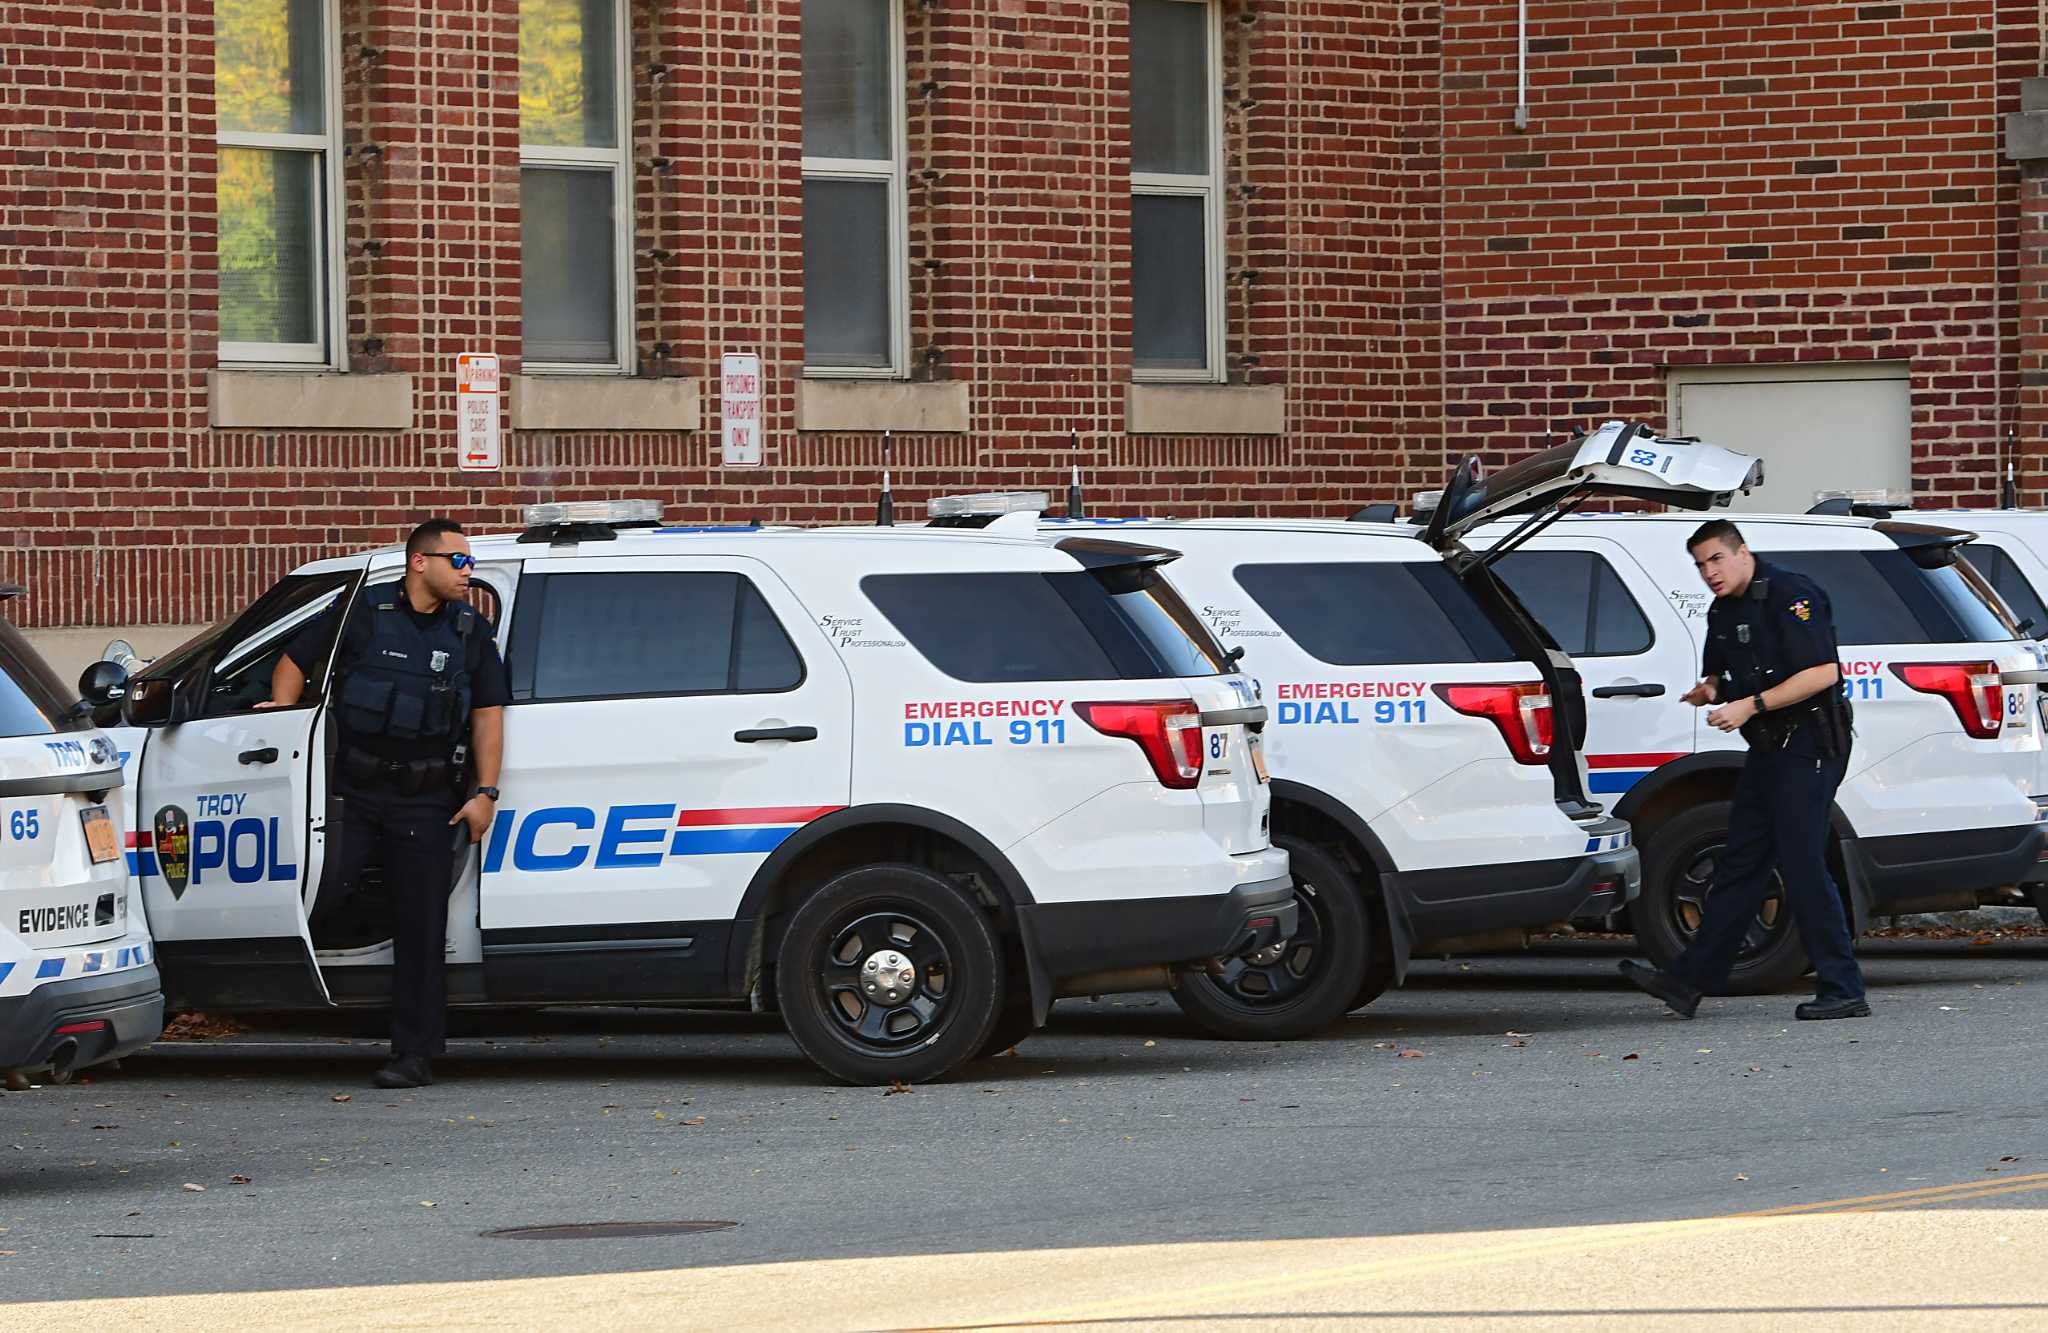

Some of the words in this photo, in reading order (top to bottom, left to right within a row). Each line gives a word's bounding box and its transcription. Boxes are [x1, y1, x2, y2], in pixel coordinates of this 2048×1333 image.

[471, 368, 497, 381] PARKING
[726, 375, 755, 393] PRISONER
[468, 400, 488, 414] POLICE
[723, 401, 758, 419] TRANSPORT
[471, 418, 486, 432] CARS
[472, 437, 486, 450] ONLY
[733, 427, 749, 446] ONLY
[1631, 449, 1657, 466] 83
[1669, 590, 1705, 599] SERVICE
[1201, 606, 1240, 616] SERVICE
[820, 615, 863, 626] SERVICE
[1212, 617, 1240, 626] TRUST
[831, 627, 862, 637] TRUST
[1220, 627, 1282, 637] PROFESSIONALISM
[840, 637, 906, 648] PROFESSIONALISM
[1278, 682, 1427, 699] EMERGENCY
[905, 699, 1065, 719] EMERGENCY
[1278, 701, 1359, 724] DIAL
[1375, 700, 1426, 723] 911
[2008, 693, 2024, 715] 88
[905, 721, 992, 746] DIAL
[1009, 719, 1064, 744] 911
[1210, 733, 1228, 759] 87
[197, 793, 247, 816] TROY
[11, 809, 39, 840] 65
[483, 803, 677, 873] ICE
[192, 817, 297, 884] POL
[19, 903, 88, 933] EVIDENCE
